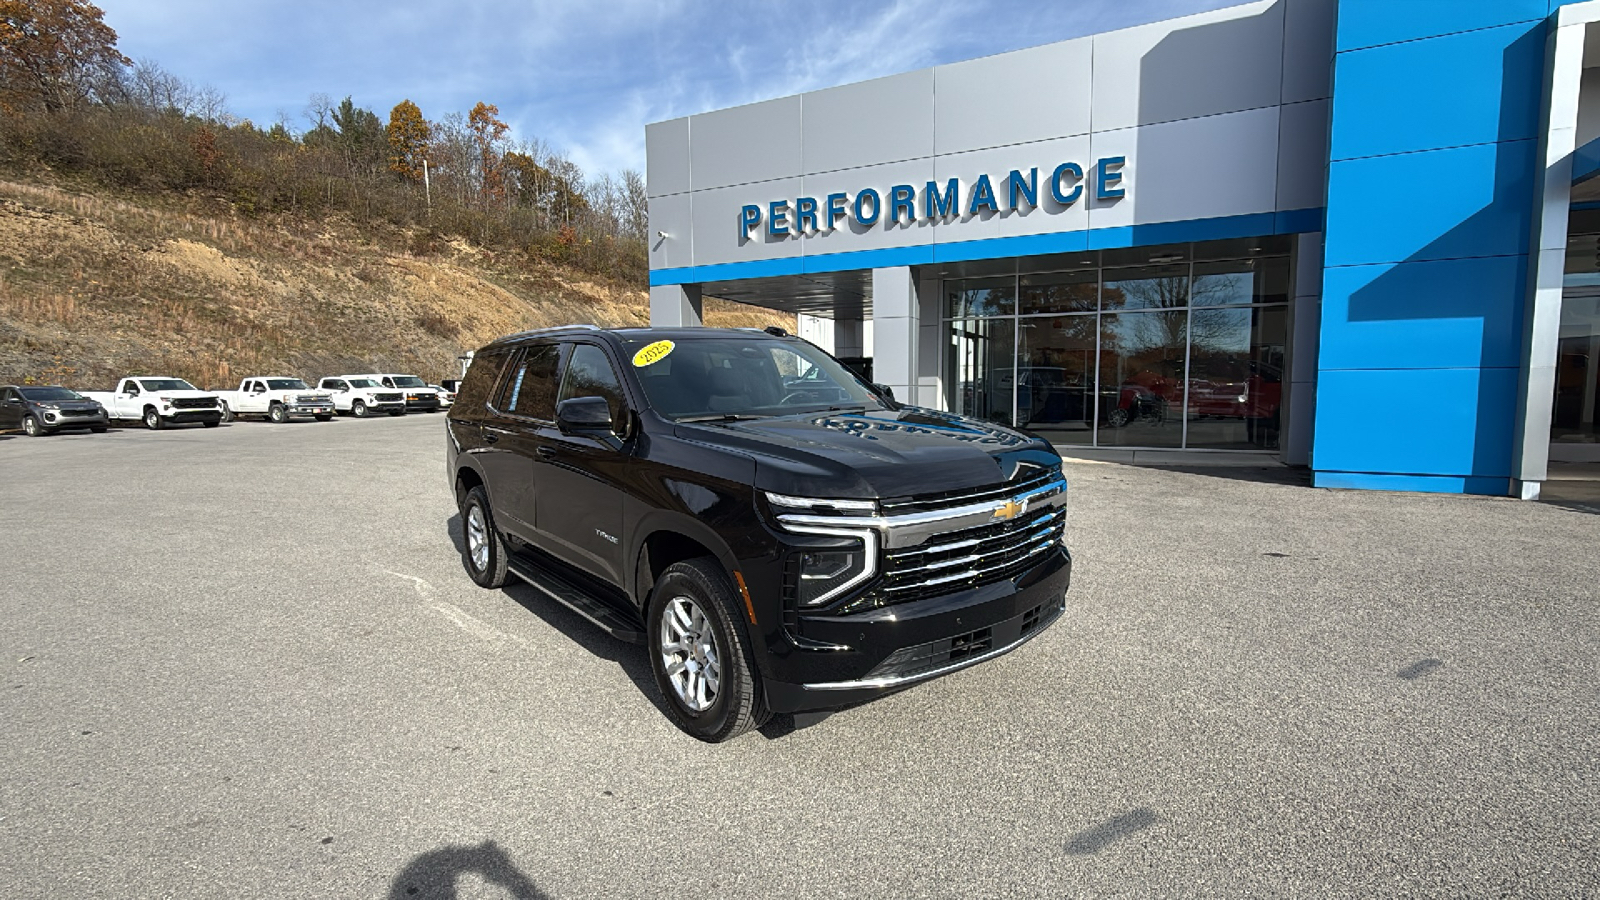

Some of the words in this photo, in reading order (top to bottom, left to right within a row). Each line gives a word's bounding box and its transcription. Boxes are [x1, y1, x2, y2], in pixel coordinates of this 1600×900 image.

[741, 155, 1126, 239] PERFORMANCE
[640, 343, 669, 363] 2025
[595, 528, 619, 545] TAHOE
